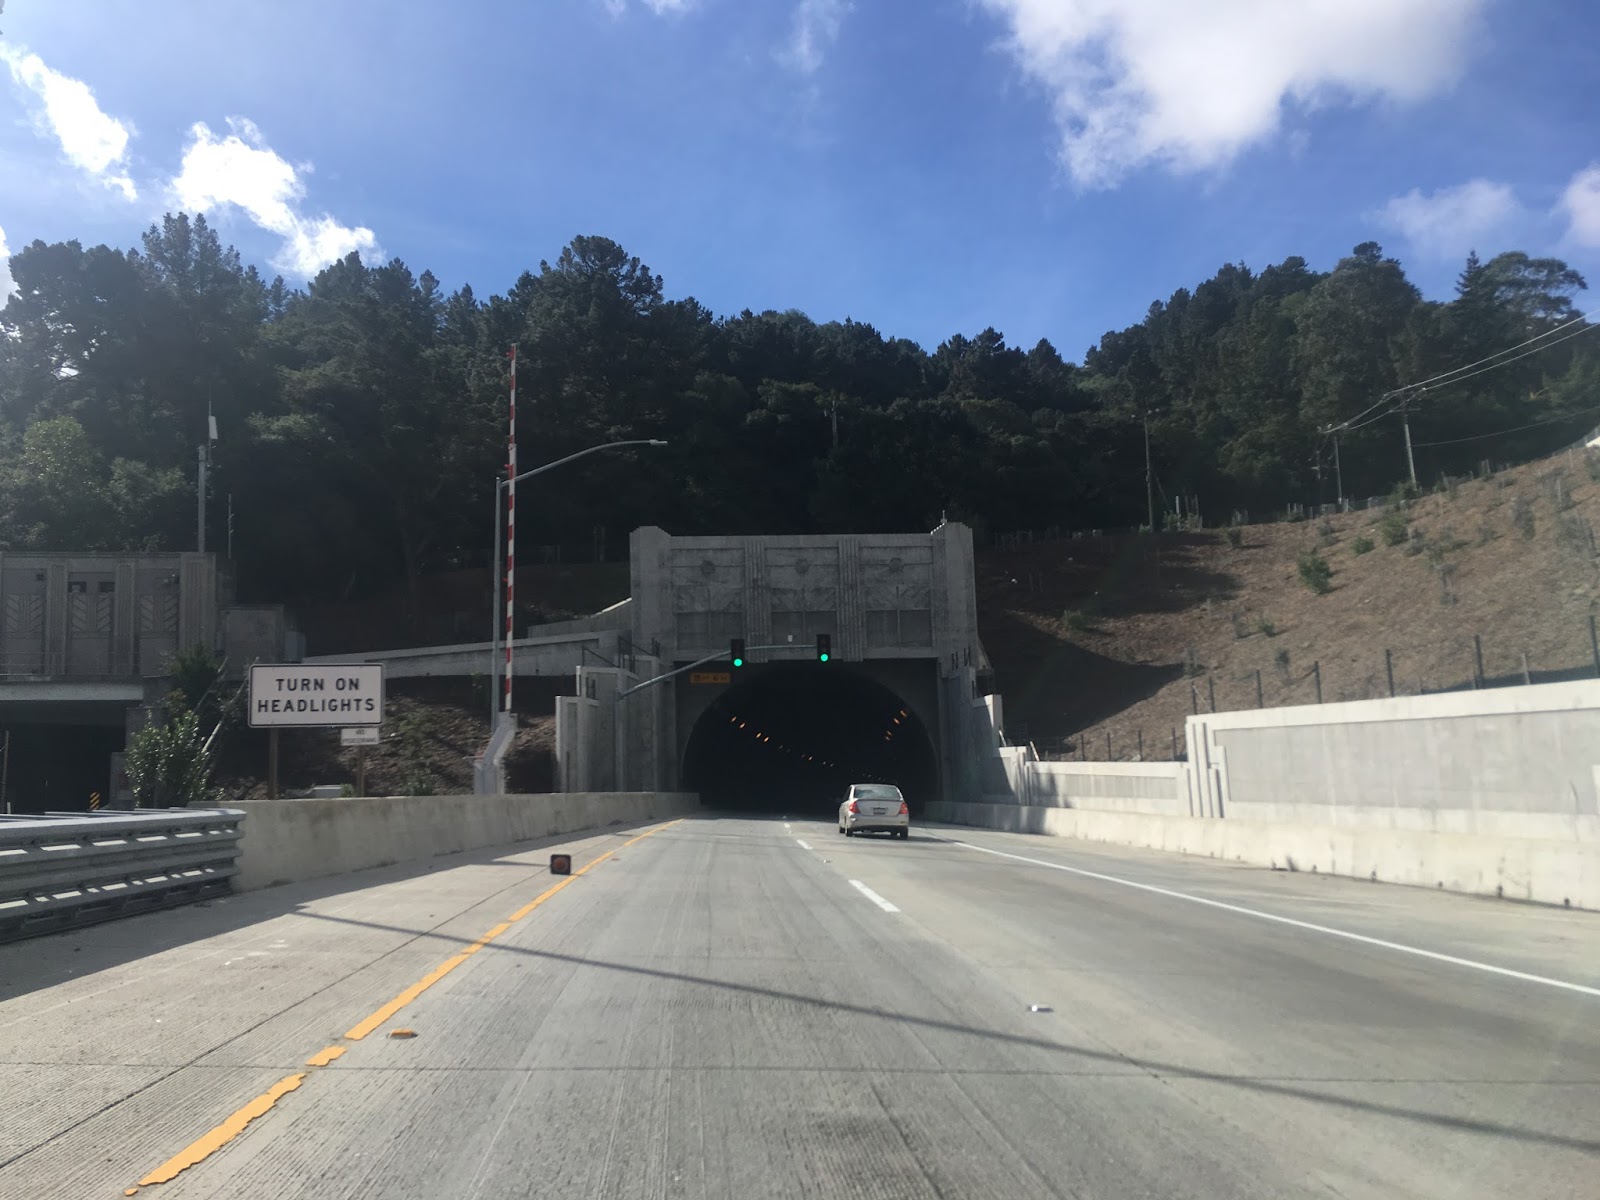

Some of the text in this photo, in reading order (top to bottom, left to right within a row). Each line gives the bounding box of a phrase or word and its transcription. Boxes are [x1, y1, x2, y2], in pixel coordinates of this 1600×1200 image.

[275, 678, 360, 691] TURN ON
[257, 698, 375, 712] HEADLIGHTS
